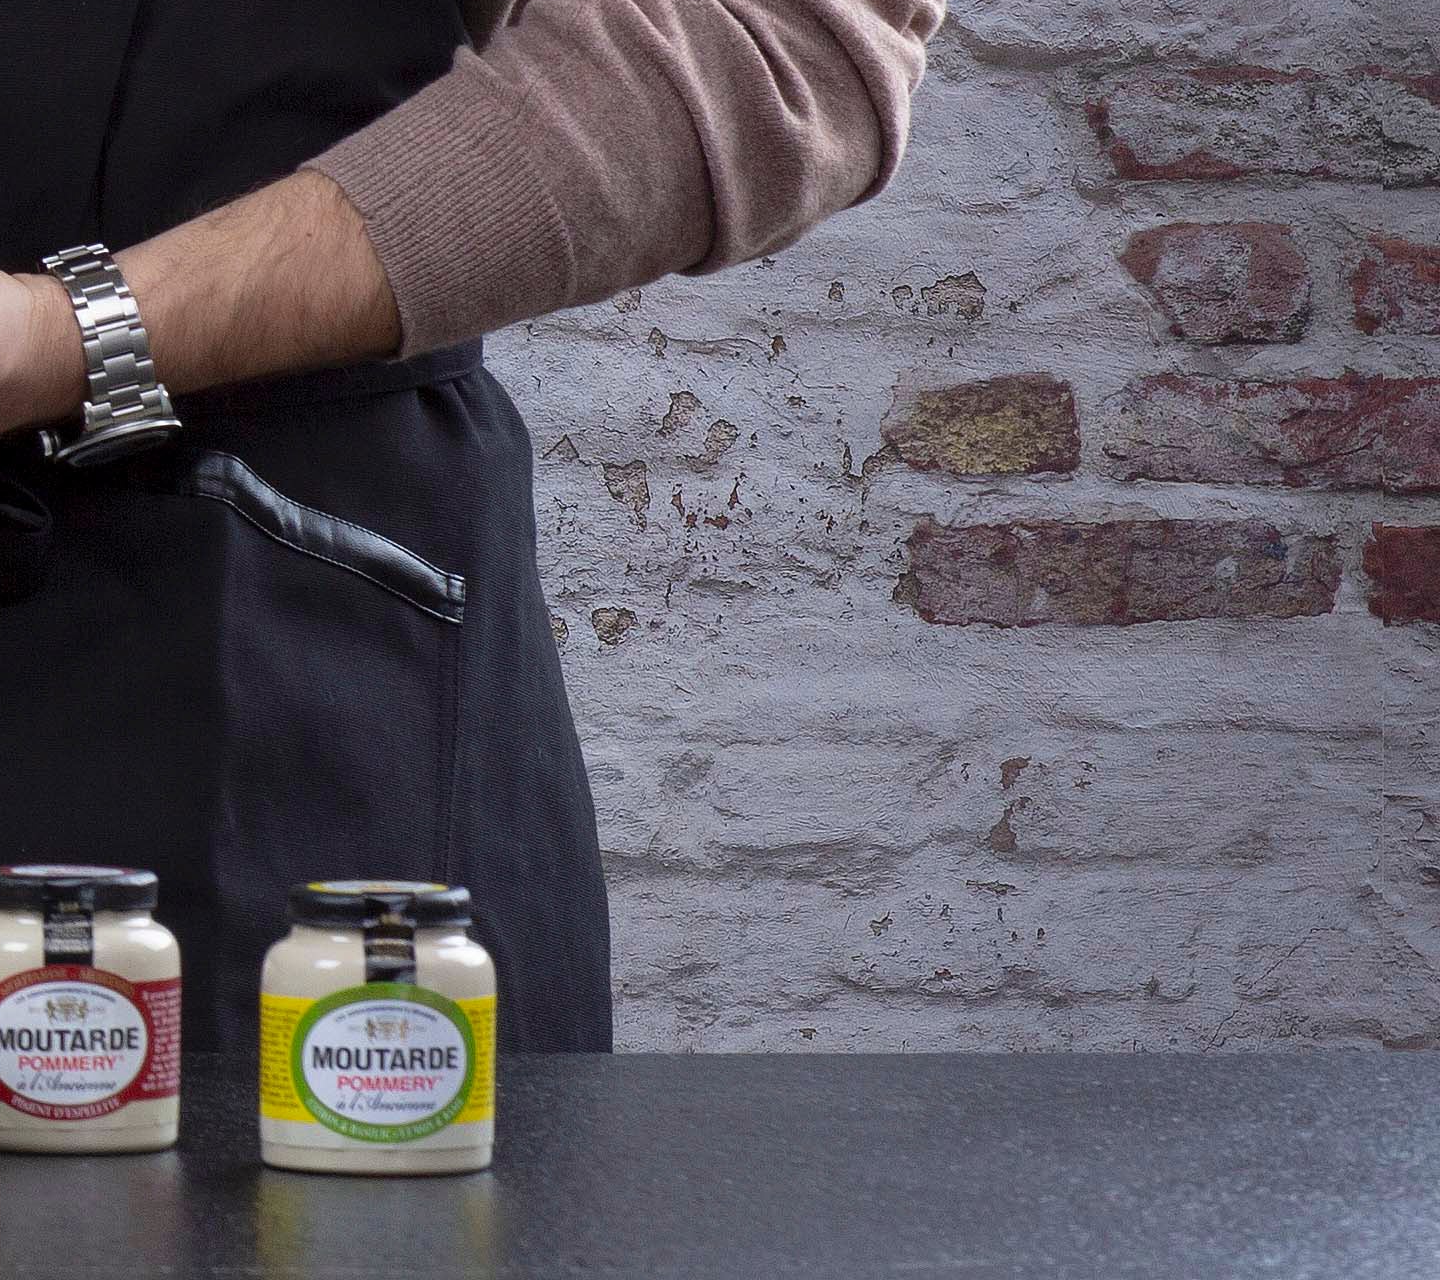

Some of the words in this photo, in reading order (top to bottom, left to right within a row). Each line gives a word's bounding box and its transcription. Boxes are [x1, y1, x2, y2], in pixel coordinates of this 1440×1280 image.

[18, 1054, 117, 1071] POMMERY
[312, 1045, 459, 1070] MOUTARDE
[336, 1075, 440, 1091] POMMERY
